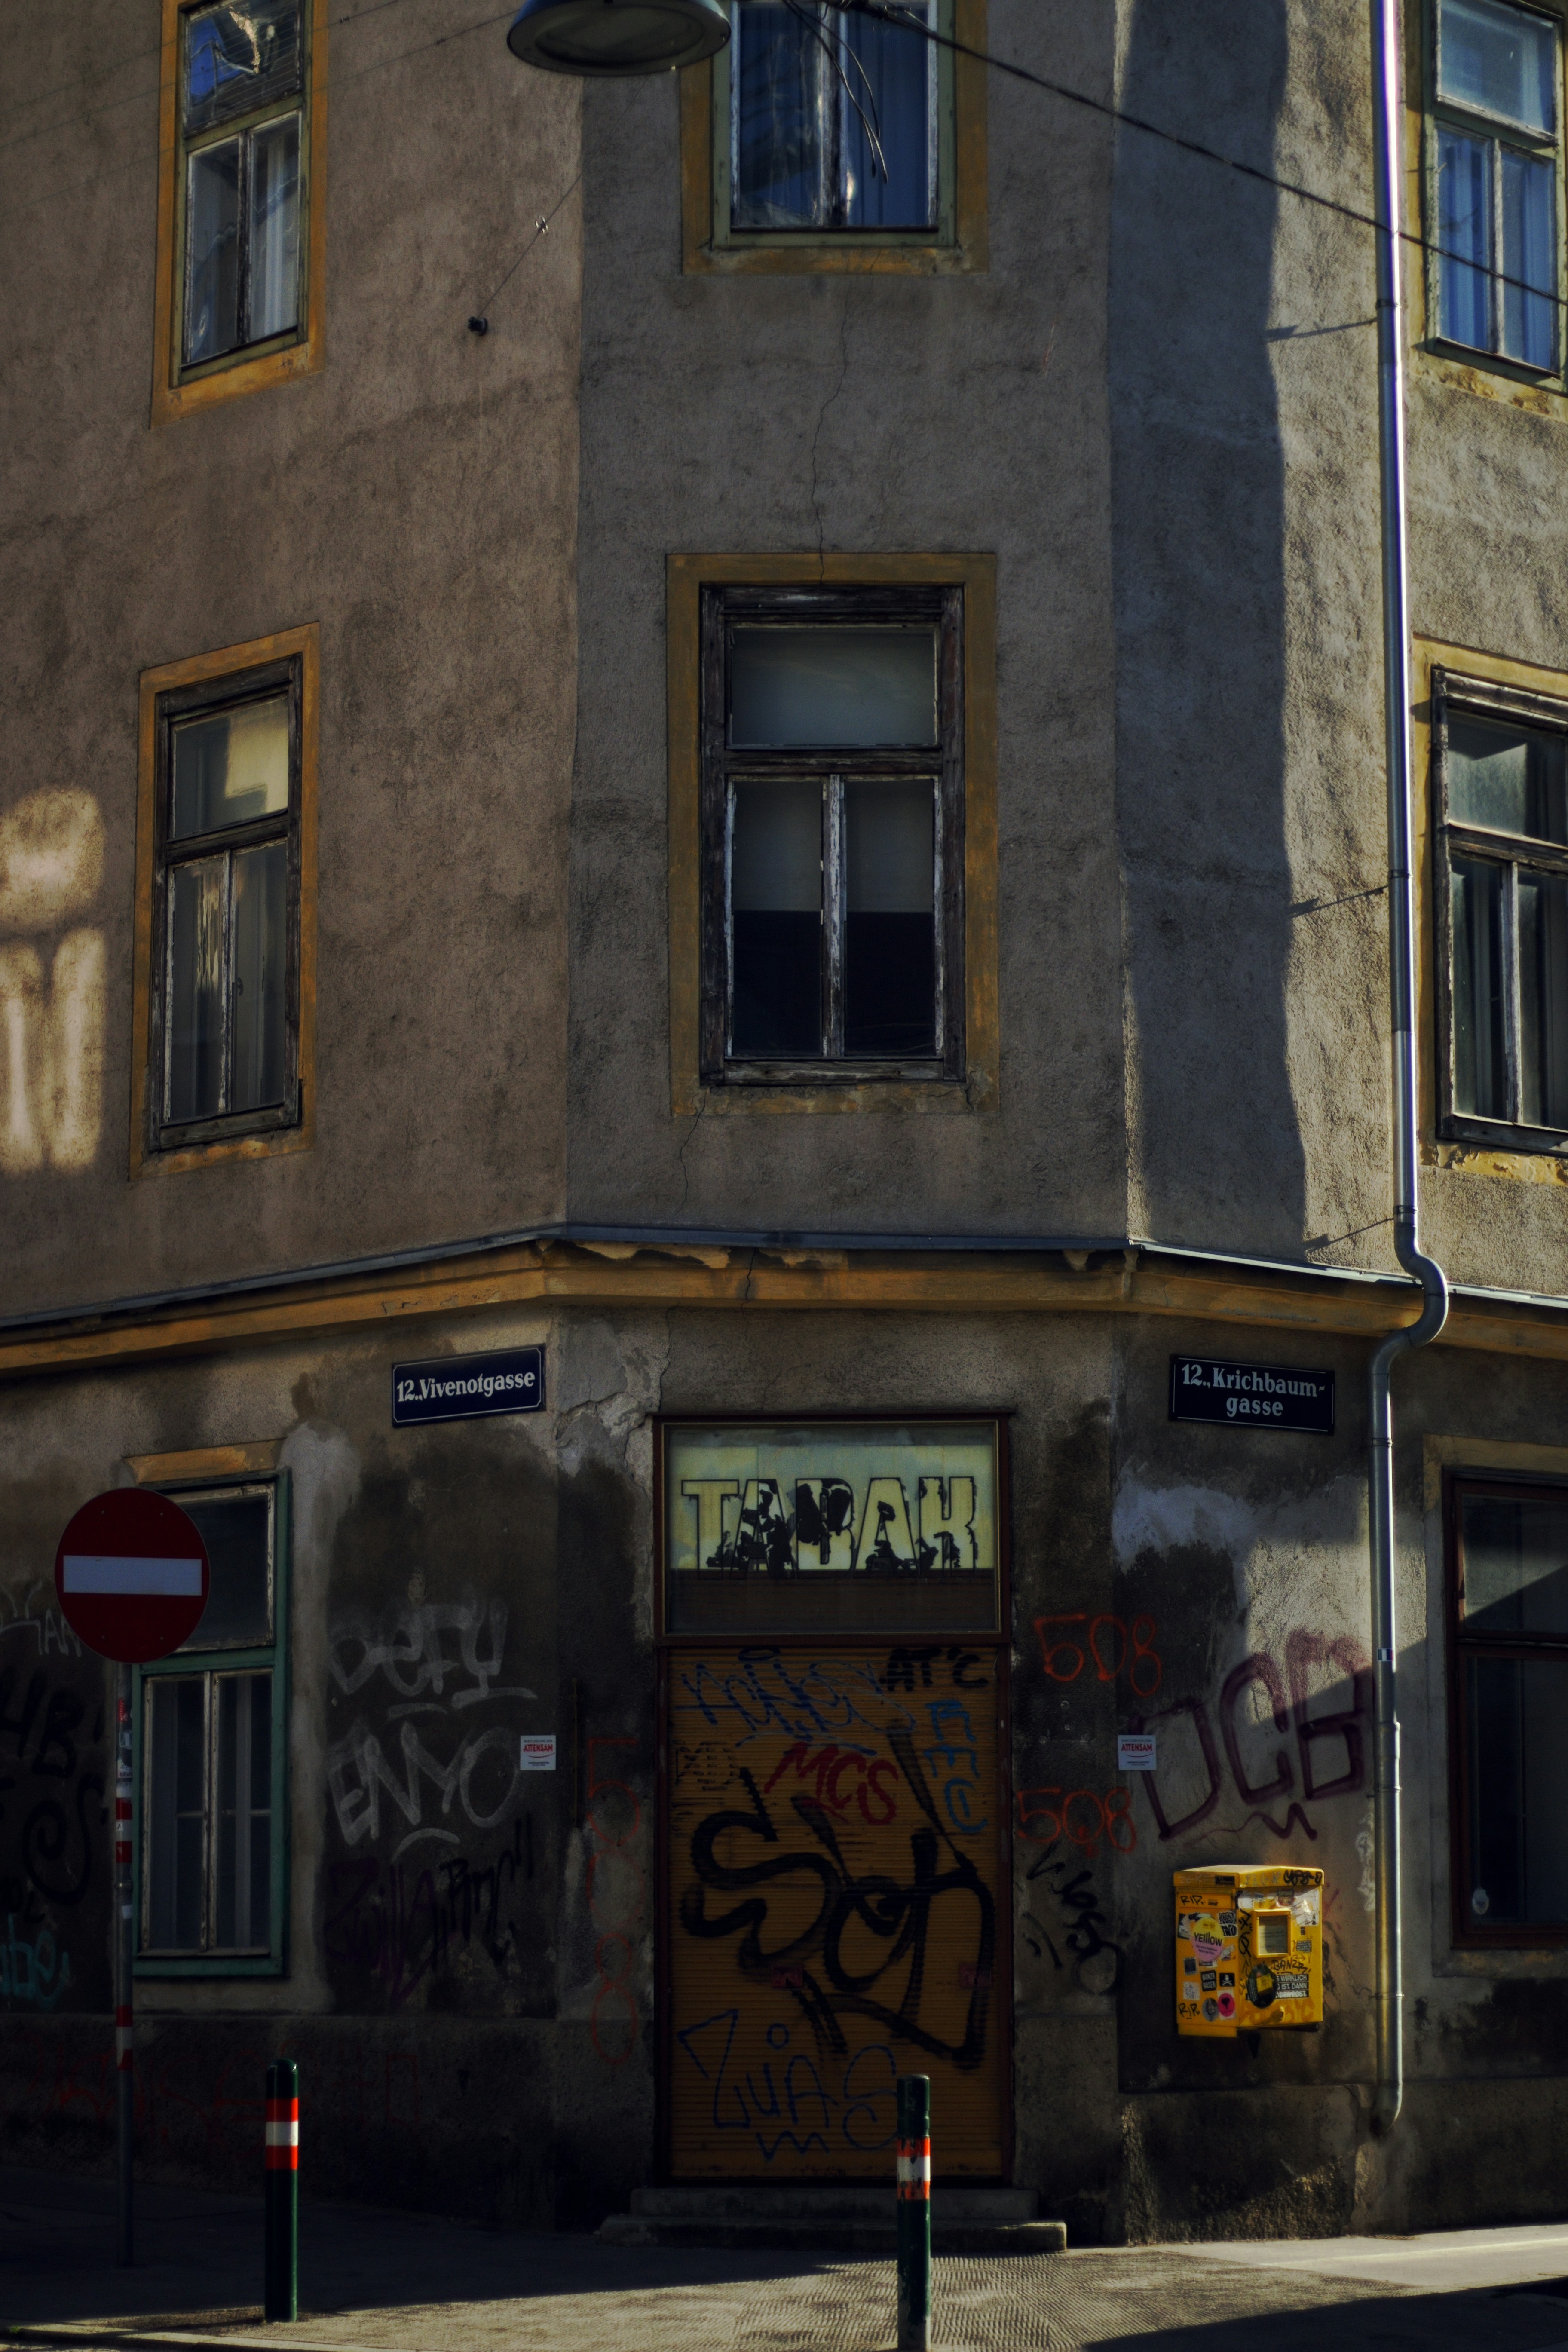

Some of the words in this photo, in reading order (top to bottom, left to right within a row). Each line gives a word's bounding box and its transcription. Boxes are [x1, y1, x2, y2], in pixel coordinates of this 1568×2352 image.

[1226, 1396, 1283, 1418] gasse
[681, 1476, 977, 1580] TABAK
[1034, 1613, 1163, 1699] 508
[523, 1744, 553, 1752] ATTENSAM
[1121, 1743, 1153, 1752] ATTENSAM
[1016, 1786, 1138, 1853] 508
